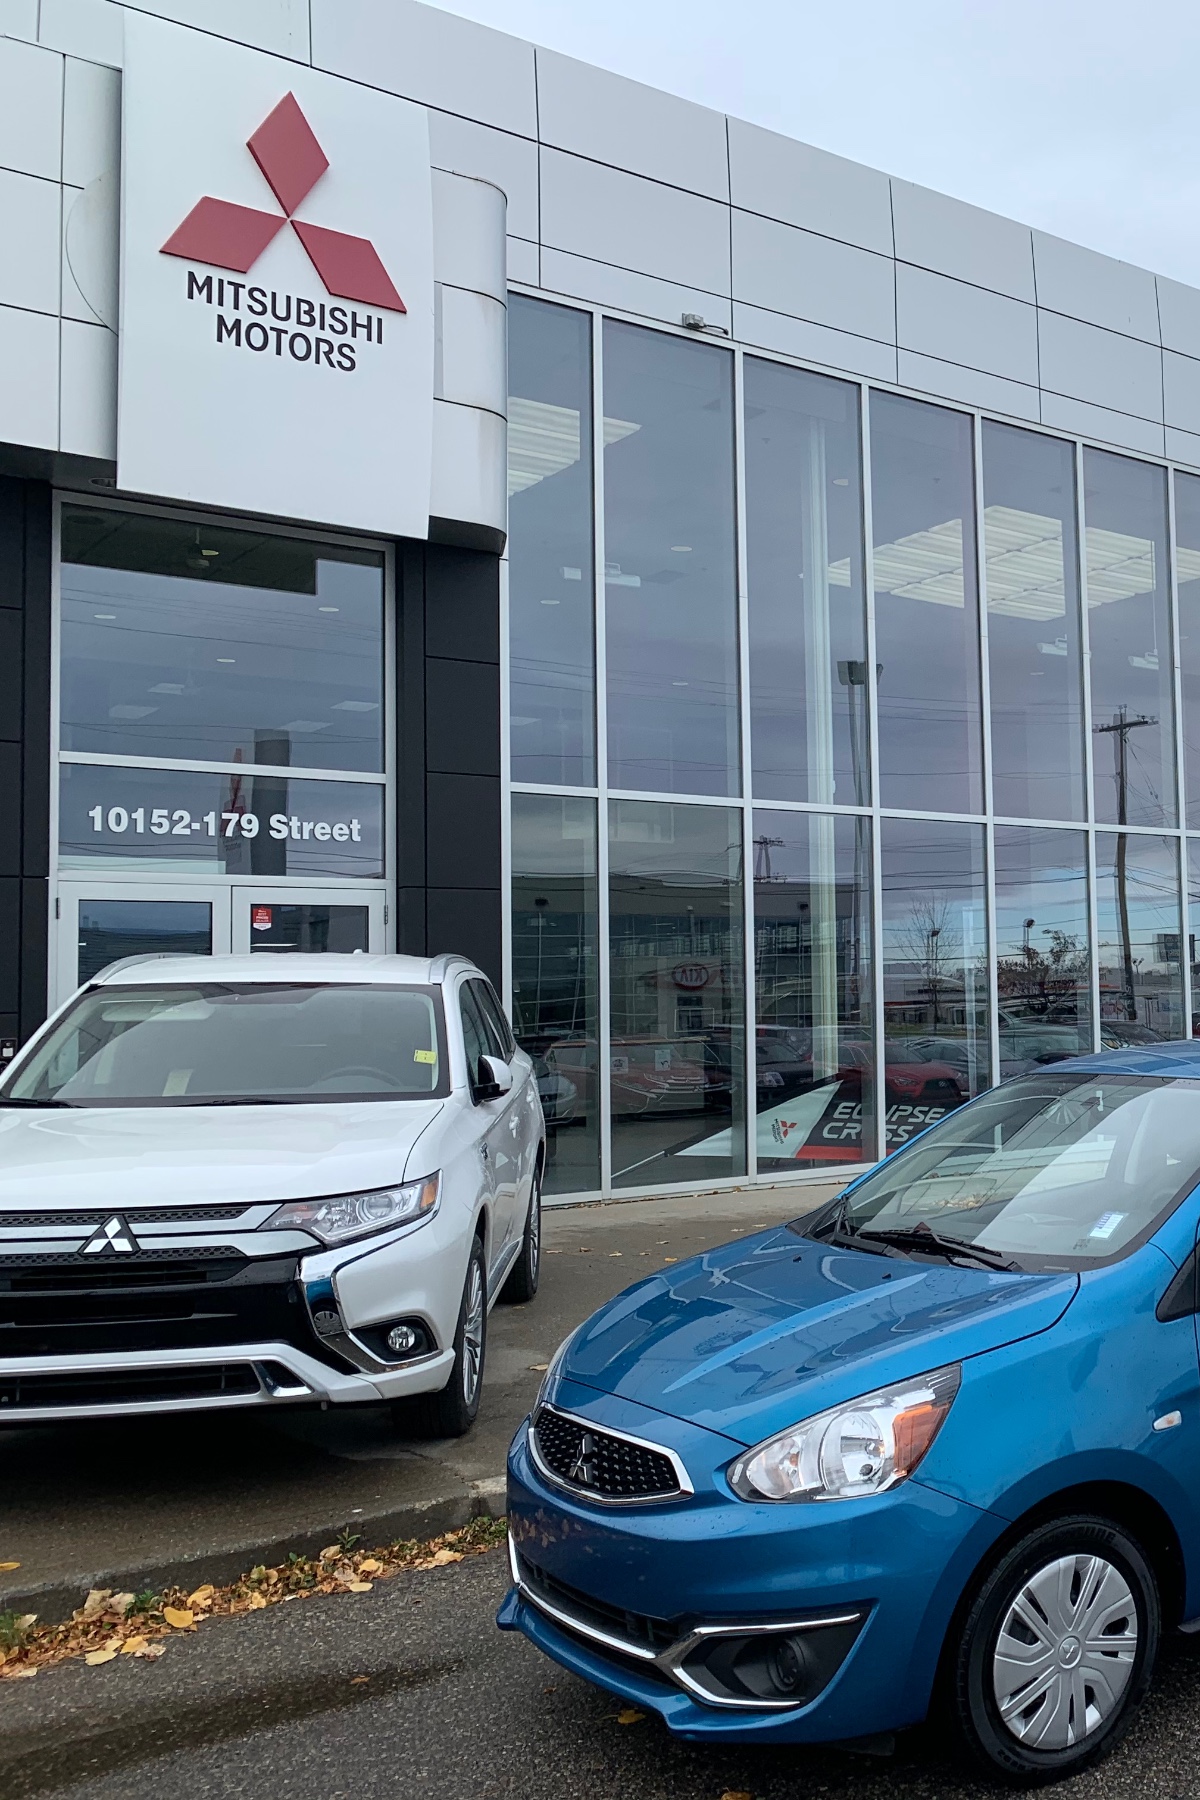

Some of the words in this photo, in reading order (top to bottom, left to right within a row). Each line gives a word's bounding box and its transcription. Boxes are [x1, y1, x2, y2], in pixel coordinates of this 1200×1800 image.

[187, 270, 383, 345] MITSUBISHI
[216, 313, 356, 372] MOTORS
[88, 805, 259, 839] 10152-179
[269, 813, 361, 842] Street
[833, 1102, 945, 1124] ECIPSE
[822, 1122, 914, 1142] CRSS
